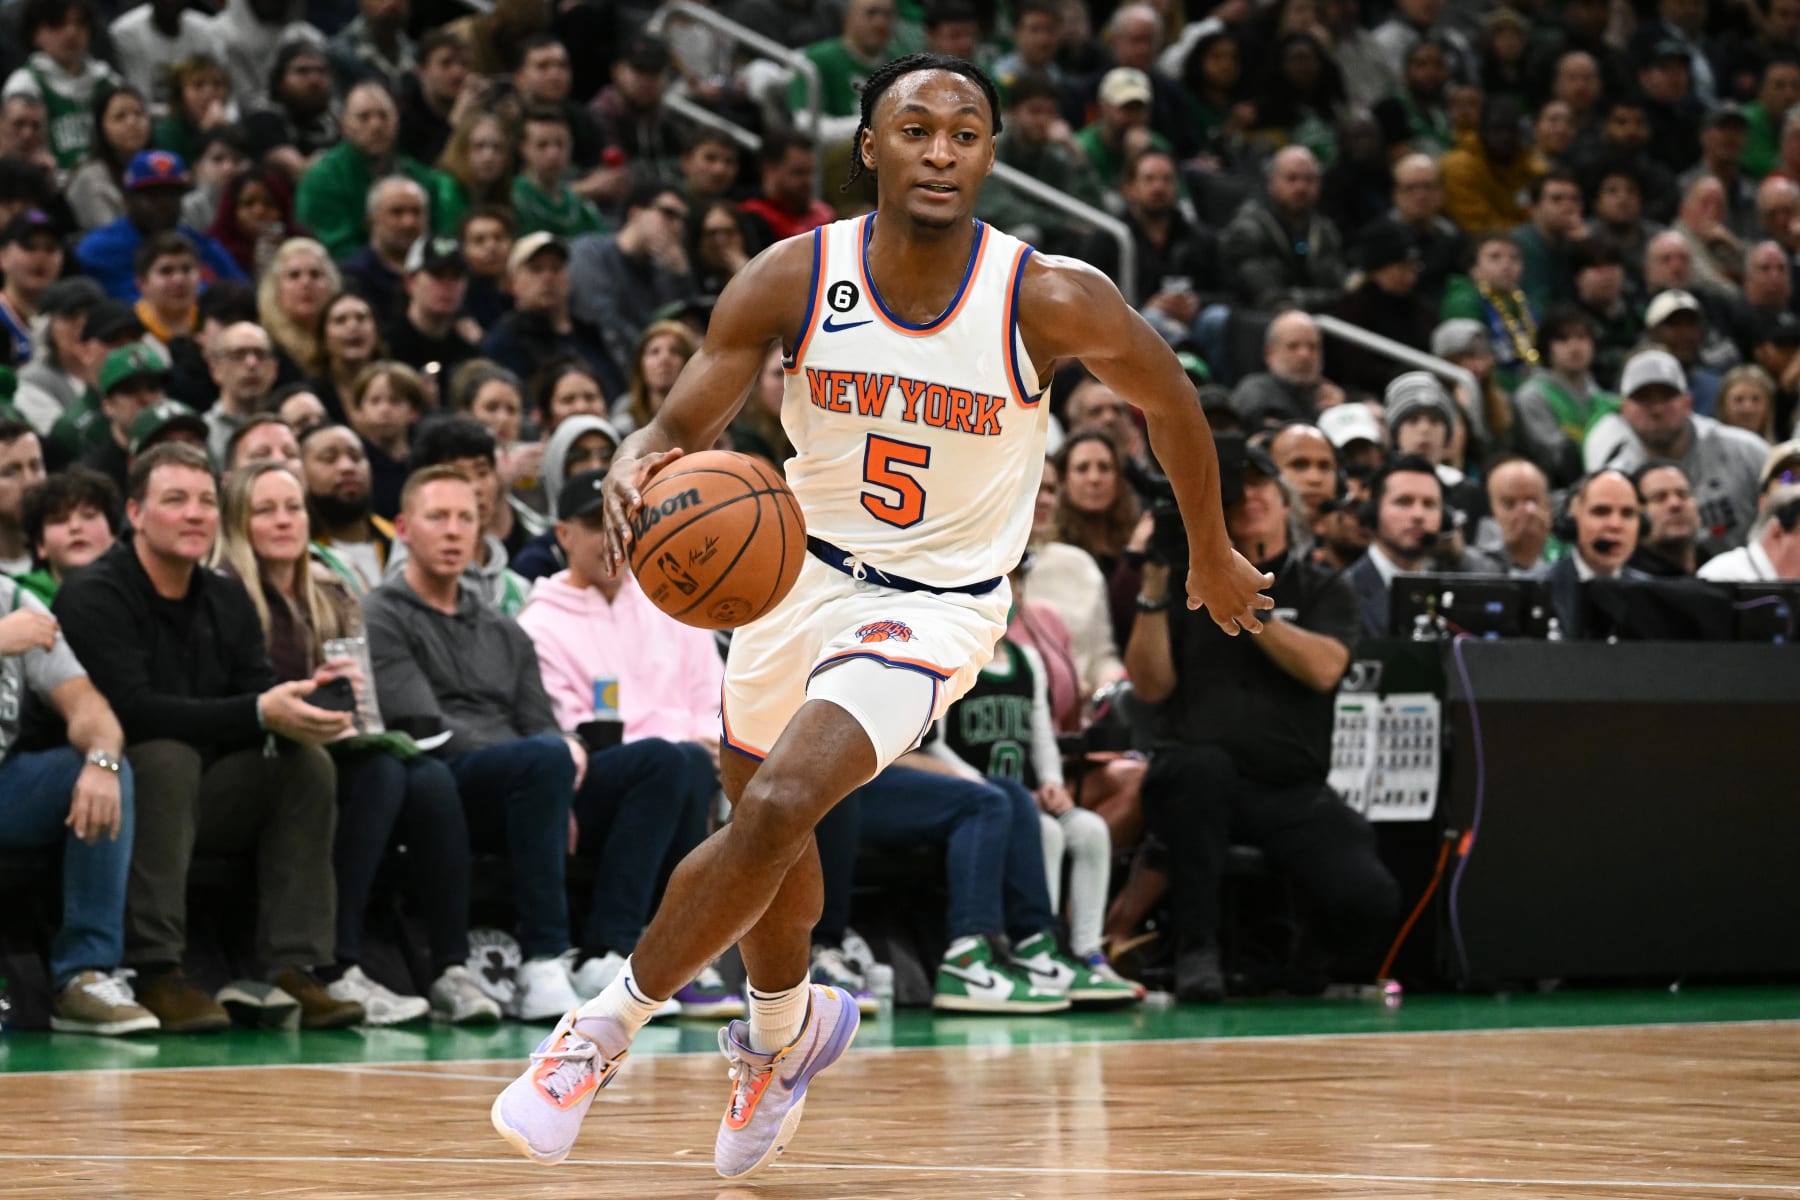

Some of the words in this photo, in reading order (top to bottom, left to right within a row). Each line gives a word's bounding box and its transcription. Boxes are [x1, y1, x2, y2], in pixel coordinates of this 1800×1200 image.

[834, 284, 853, 310] 6
[806, 368, 894, 417] NEW
[899, 378, 1006, 435] YORK
[860, 433, 931, 529] 5
[630, 487, 702, 548] ilson
